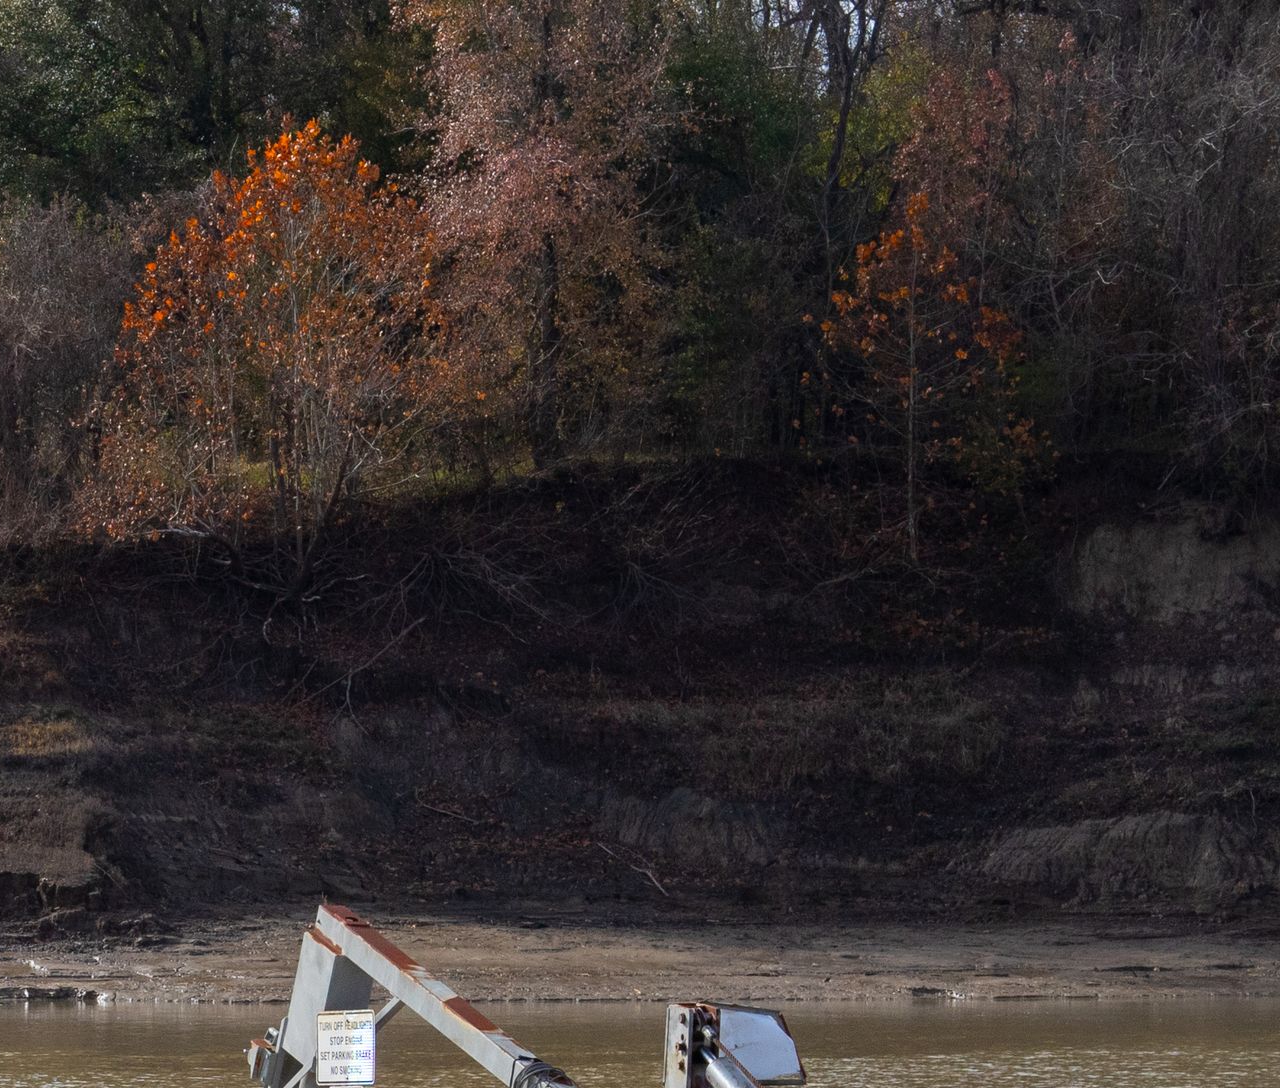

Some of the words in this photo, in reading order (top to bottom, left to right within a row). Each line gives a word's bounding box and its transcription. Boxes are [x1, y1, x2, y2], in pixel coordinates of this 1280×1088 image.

[319, 1021, 332, 1031] TURN
[334, 1021, 343, 1031] OFF
[344, 1020, 372, 1030] HEADLIGHTS
[329, 1036, 344, 1045] STOP
[320, 1051, 330, 1060] SET
[331, 1050, 354, 1060] PARKING
[355, 1050, 372, 1060] BRAKE
[330, 1066, 338, 1075] NO
